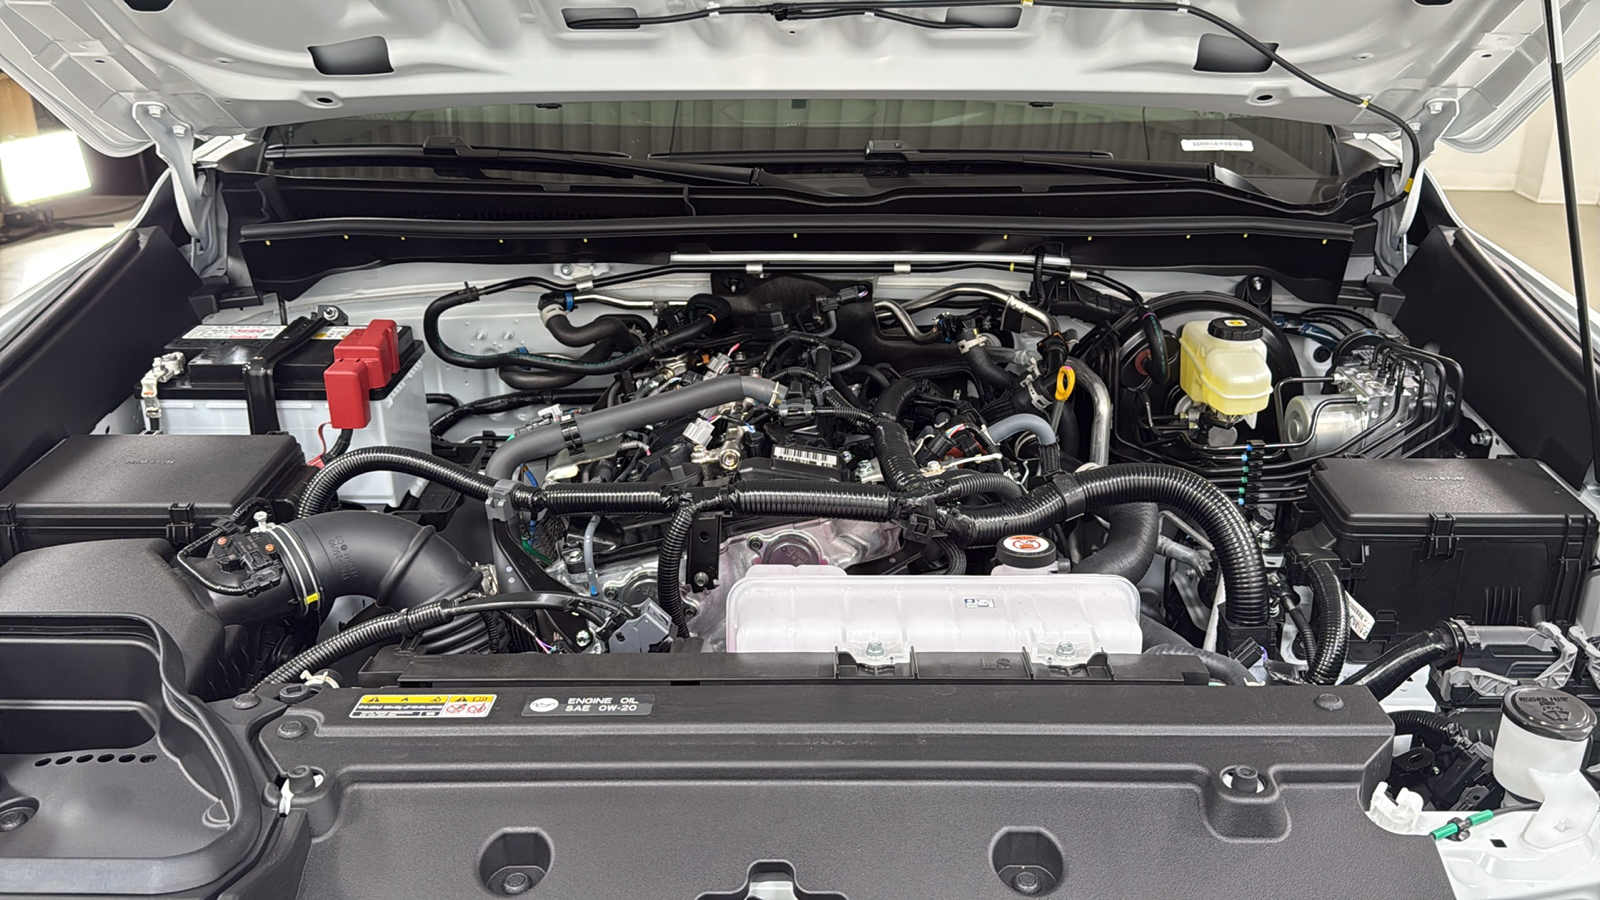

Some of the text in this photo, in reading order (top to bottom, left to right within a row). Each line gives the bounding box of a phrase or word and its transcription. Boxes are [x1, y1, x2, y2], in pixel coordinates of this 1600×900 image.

[567, 697, 613, 705] ENGINE
[565, 704, 638, 712] SAE 0W-20
